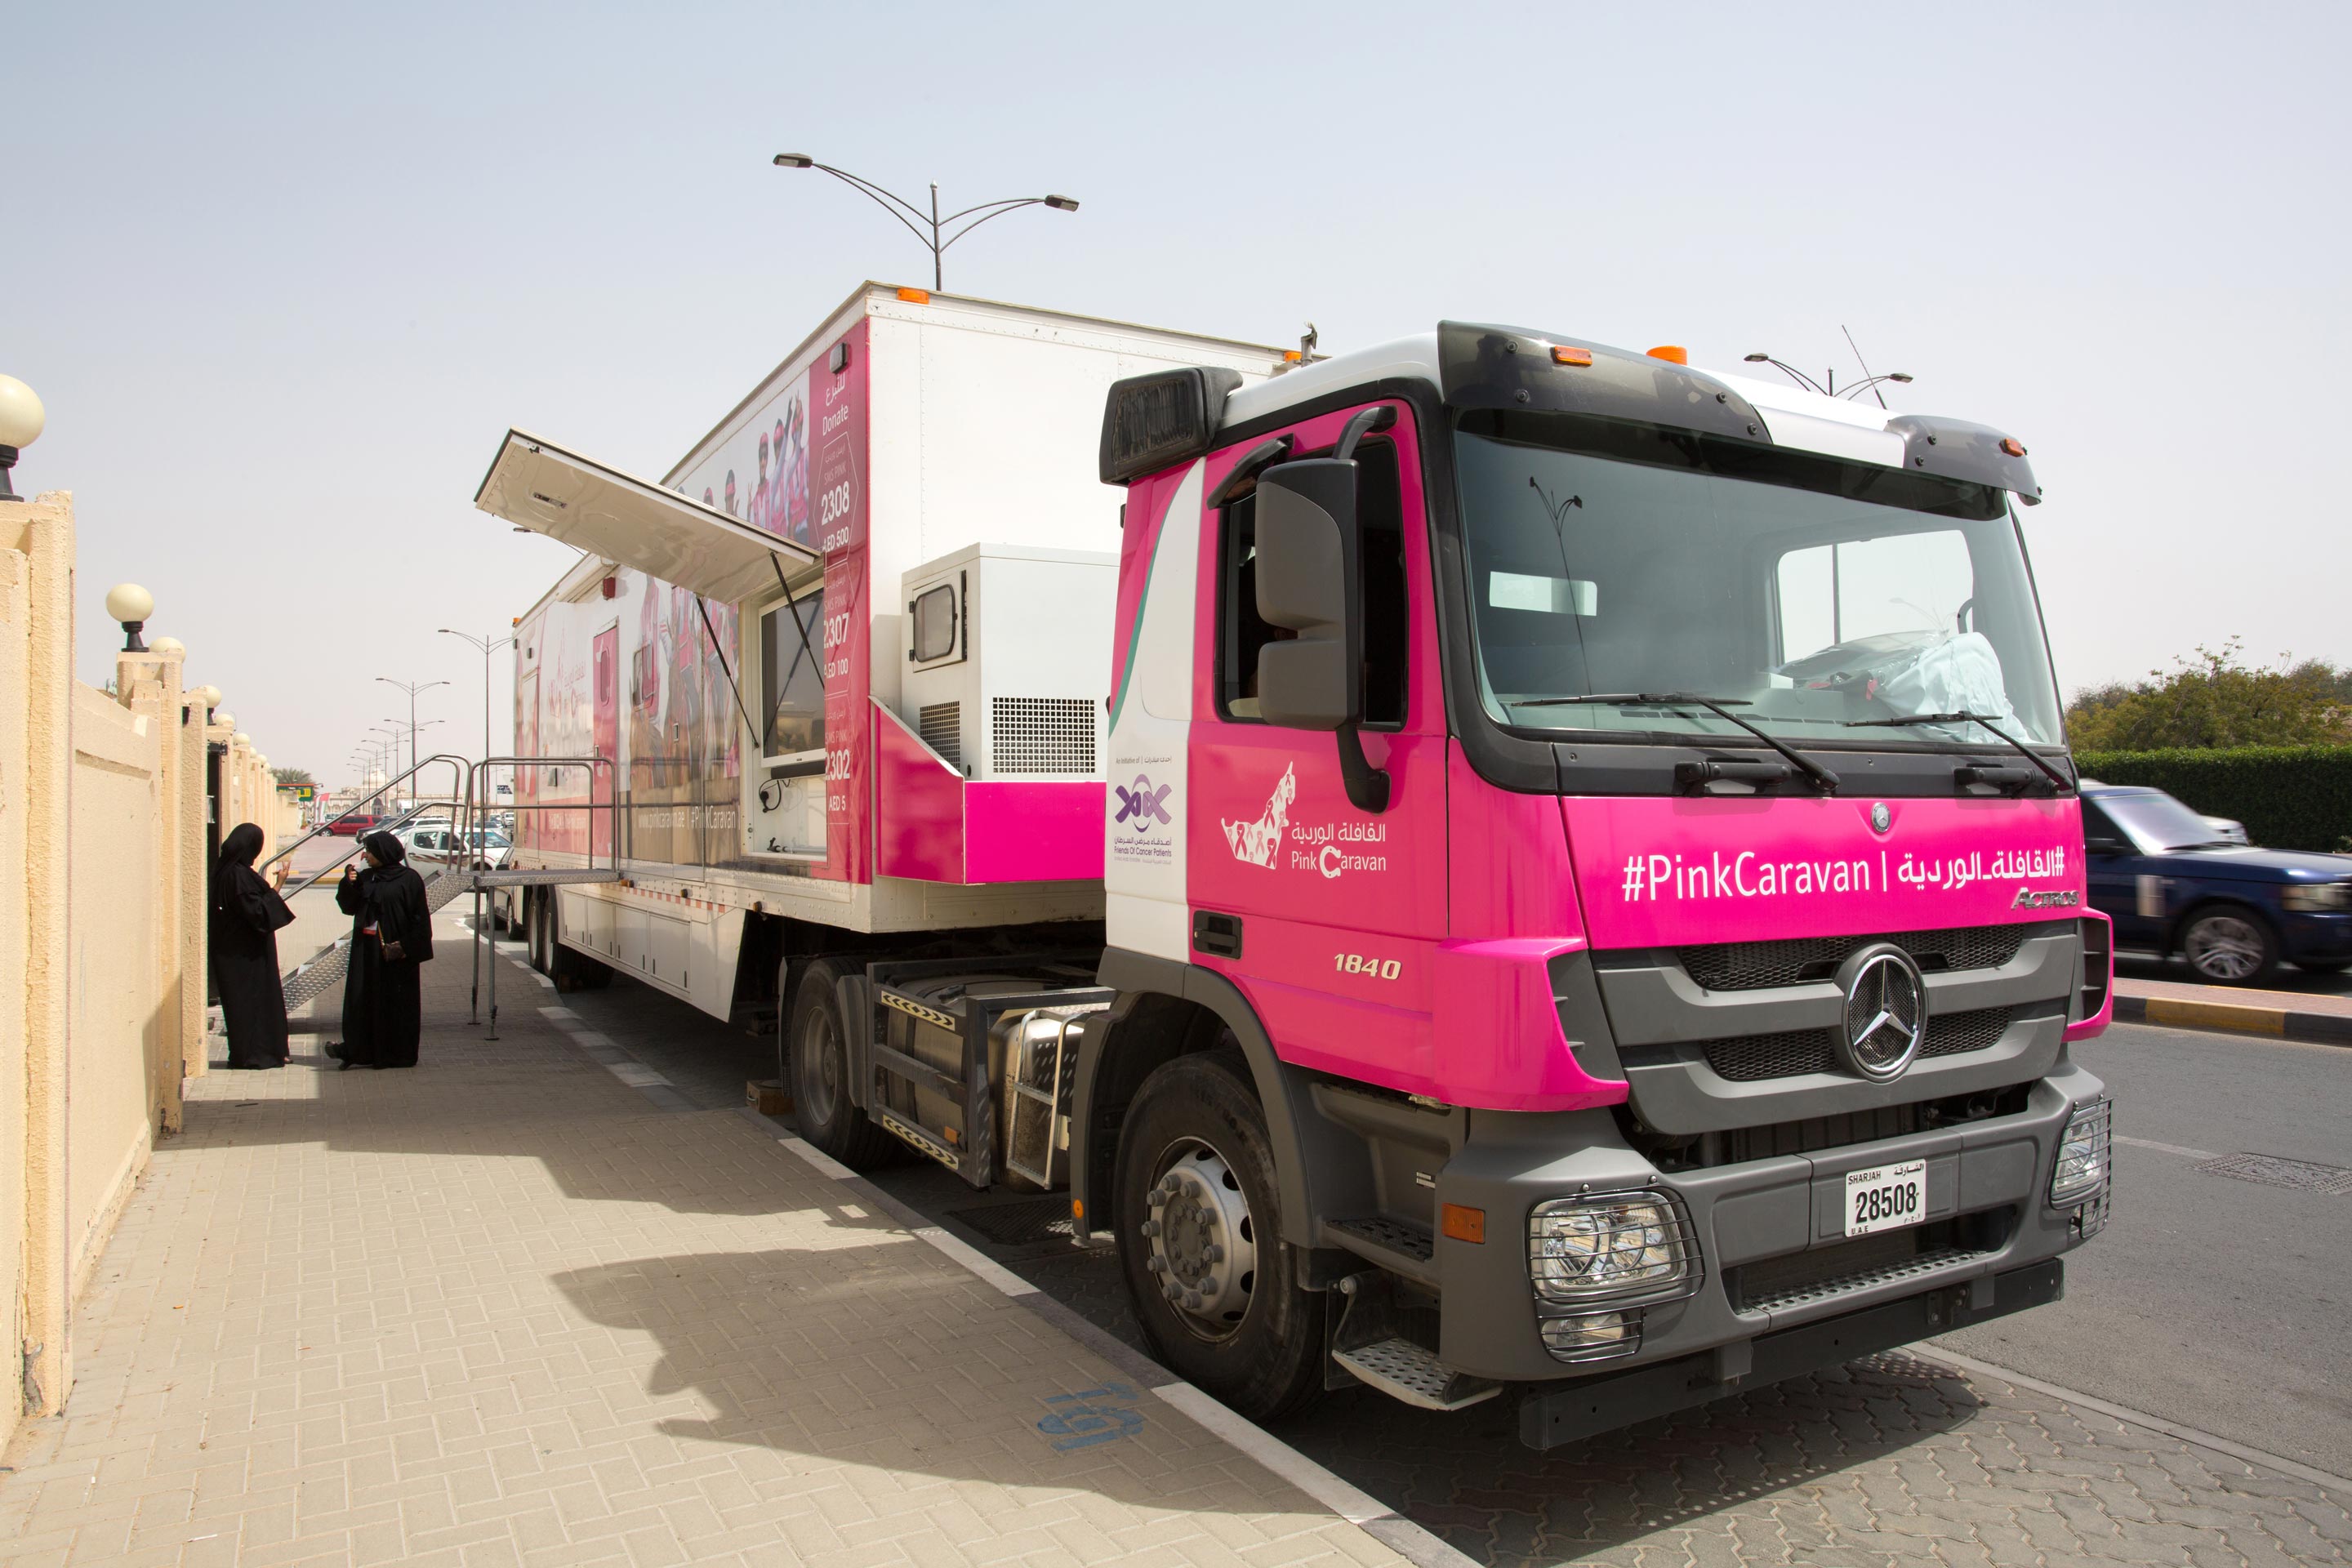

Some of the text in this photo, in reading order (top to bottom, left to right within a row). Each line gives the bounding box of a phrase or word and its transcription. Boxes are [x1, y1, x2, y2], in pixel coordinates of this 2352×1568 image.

[822, 403, 849, 436] Donate
[821, 480, 850, 526] 2308
[836, 526, 849, 548] 500
[823, 612, 849, 649] 2307
[837, 658, 849, 676] 100
[825, 748, 850, 781] 2302
[691, 805, 736, 830] #PinkCaravan
[828, 795, 846, 811] AED 5
[1291, 822, 1386, 844] القافلة الوردية
[1114, 846, 1129, 854] Friends
[1135, 847, 1152, 856] Cancer
[1153, 848, 1172, 858] Patients
[1291, 845, 1387, 879] Pink Caravan
[1622, 851, 1870, 902] #PinkCaravan
[1897, 846, 2065, 890] #القافلة_الوردية
[1334, 953, 1401, 980] 1840
[1848, 1170, 1882, 1185] SHARJAH
[1855, 1182, 1917, 1223] 28508
